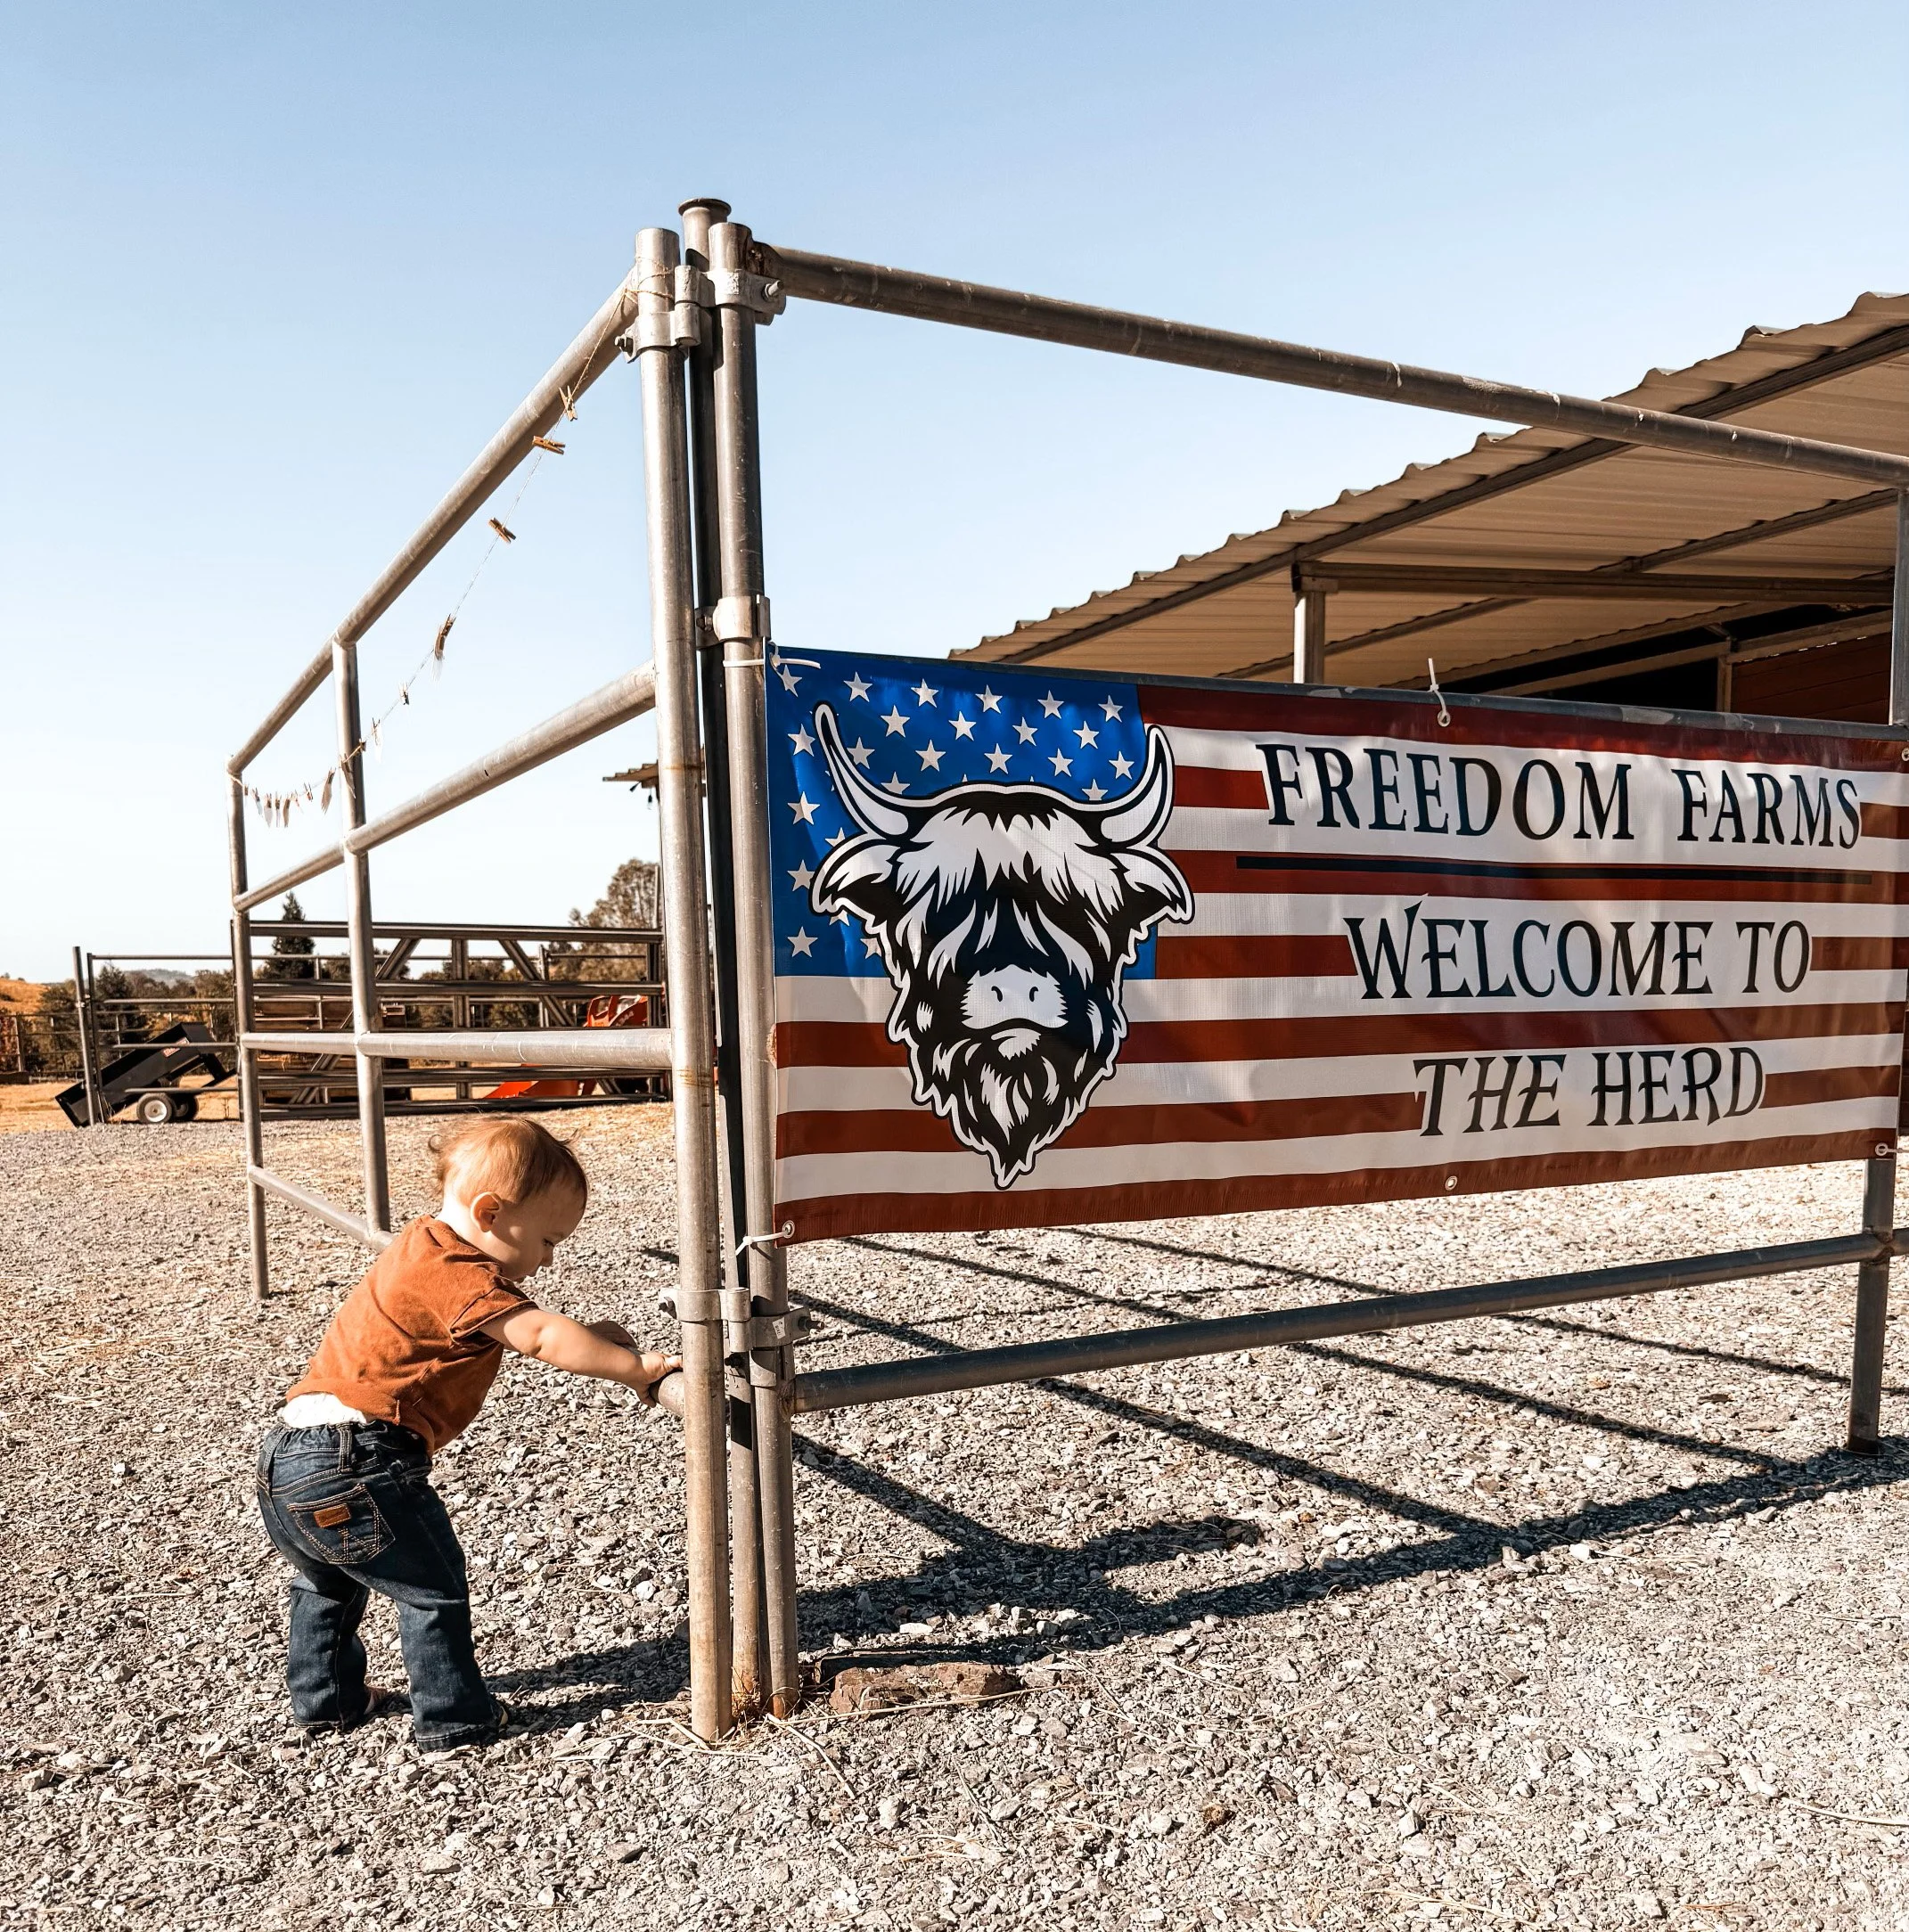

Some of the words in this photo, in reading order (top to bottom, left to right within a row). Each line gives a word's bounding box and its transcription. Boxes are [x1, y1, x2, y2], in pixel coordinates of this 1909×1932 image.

[1256, 744, 1635, 840] FREEDOM
[1671, 768, 1860, 849] FARMS
[1343, 899, 1714, 1000] WELCOME
[1736, 920, 1810, 994] TO
[1413, 1054, 1567, 1137] THE
[1586, 1046, 1764, 1126] HERD
